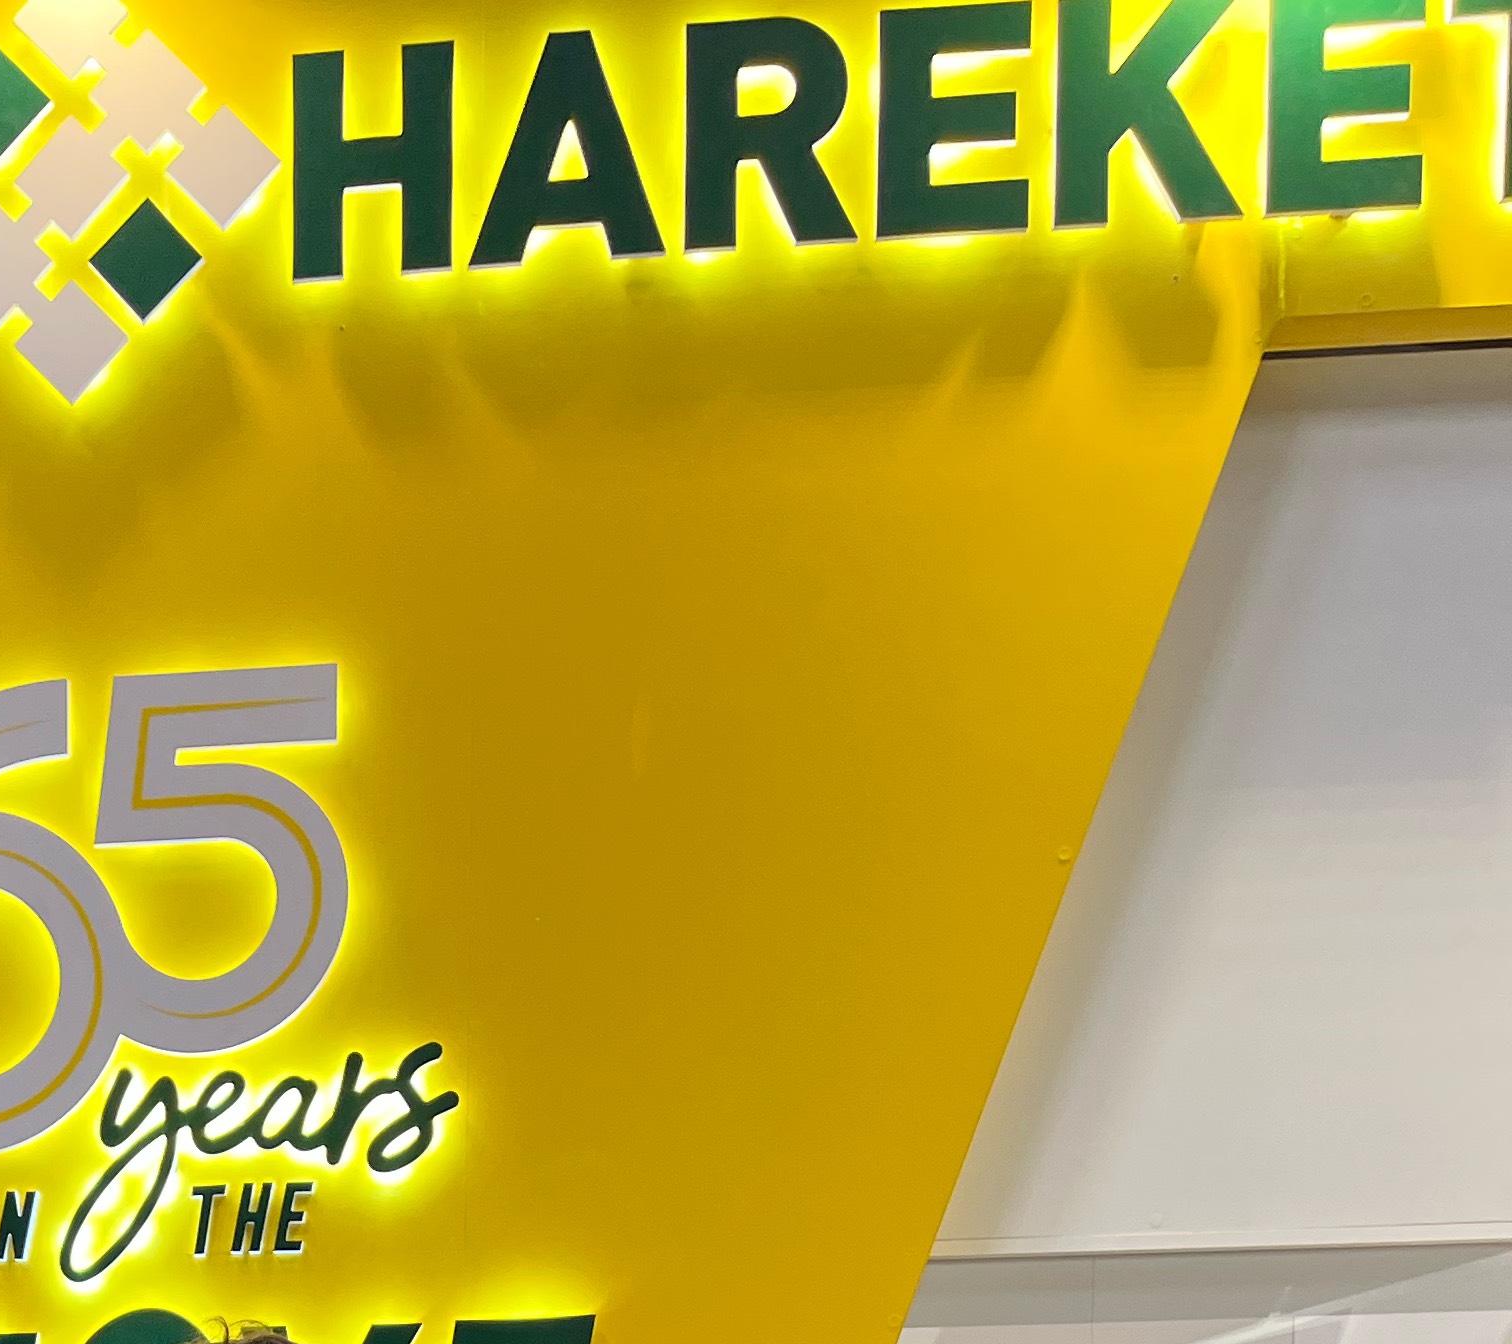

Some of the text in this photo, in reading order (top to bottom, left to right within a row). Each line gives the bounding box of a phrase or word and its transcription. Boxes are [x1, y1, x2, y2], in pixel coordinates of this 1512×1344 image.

[292, 0, 1512, 281] HAREKE
[60, 1042, 458, 1283] years
[192, 1182, 314, 1255] THE
